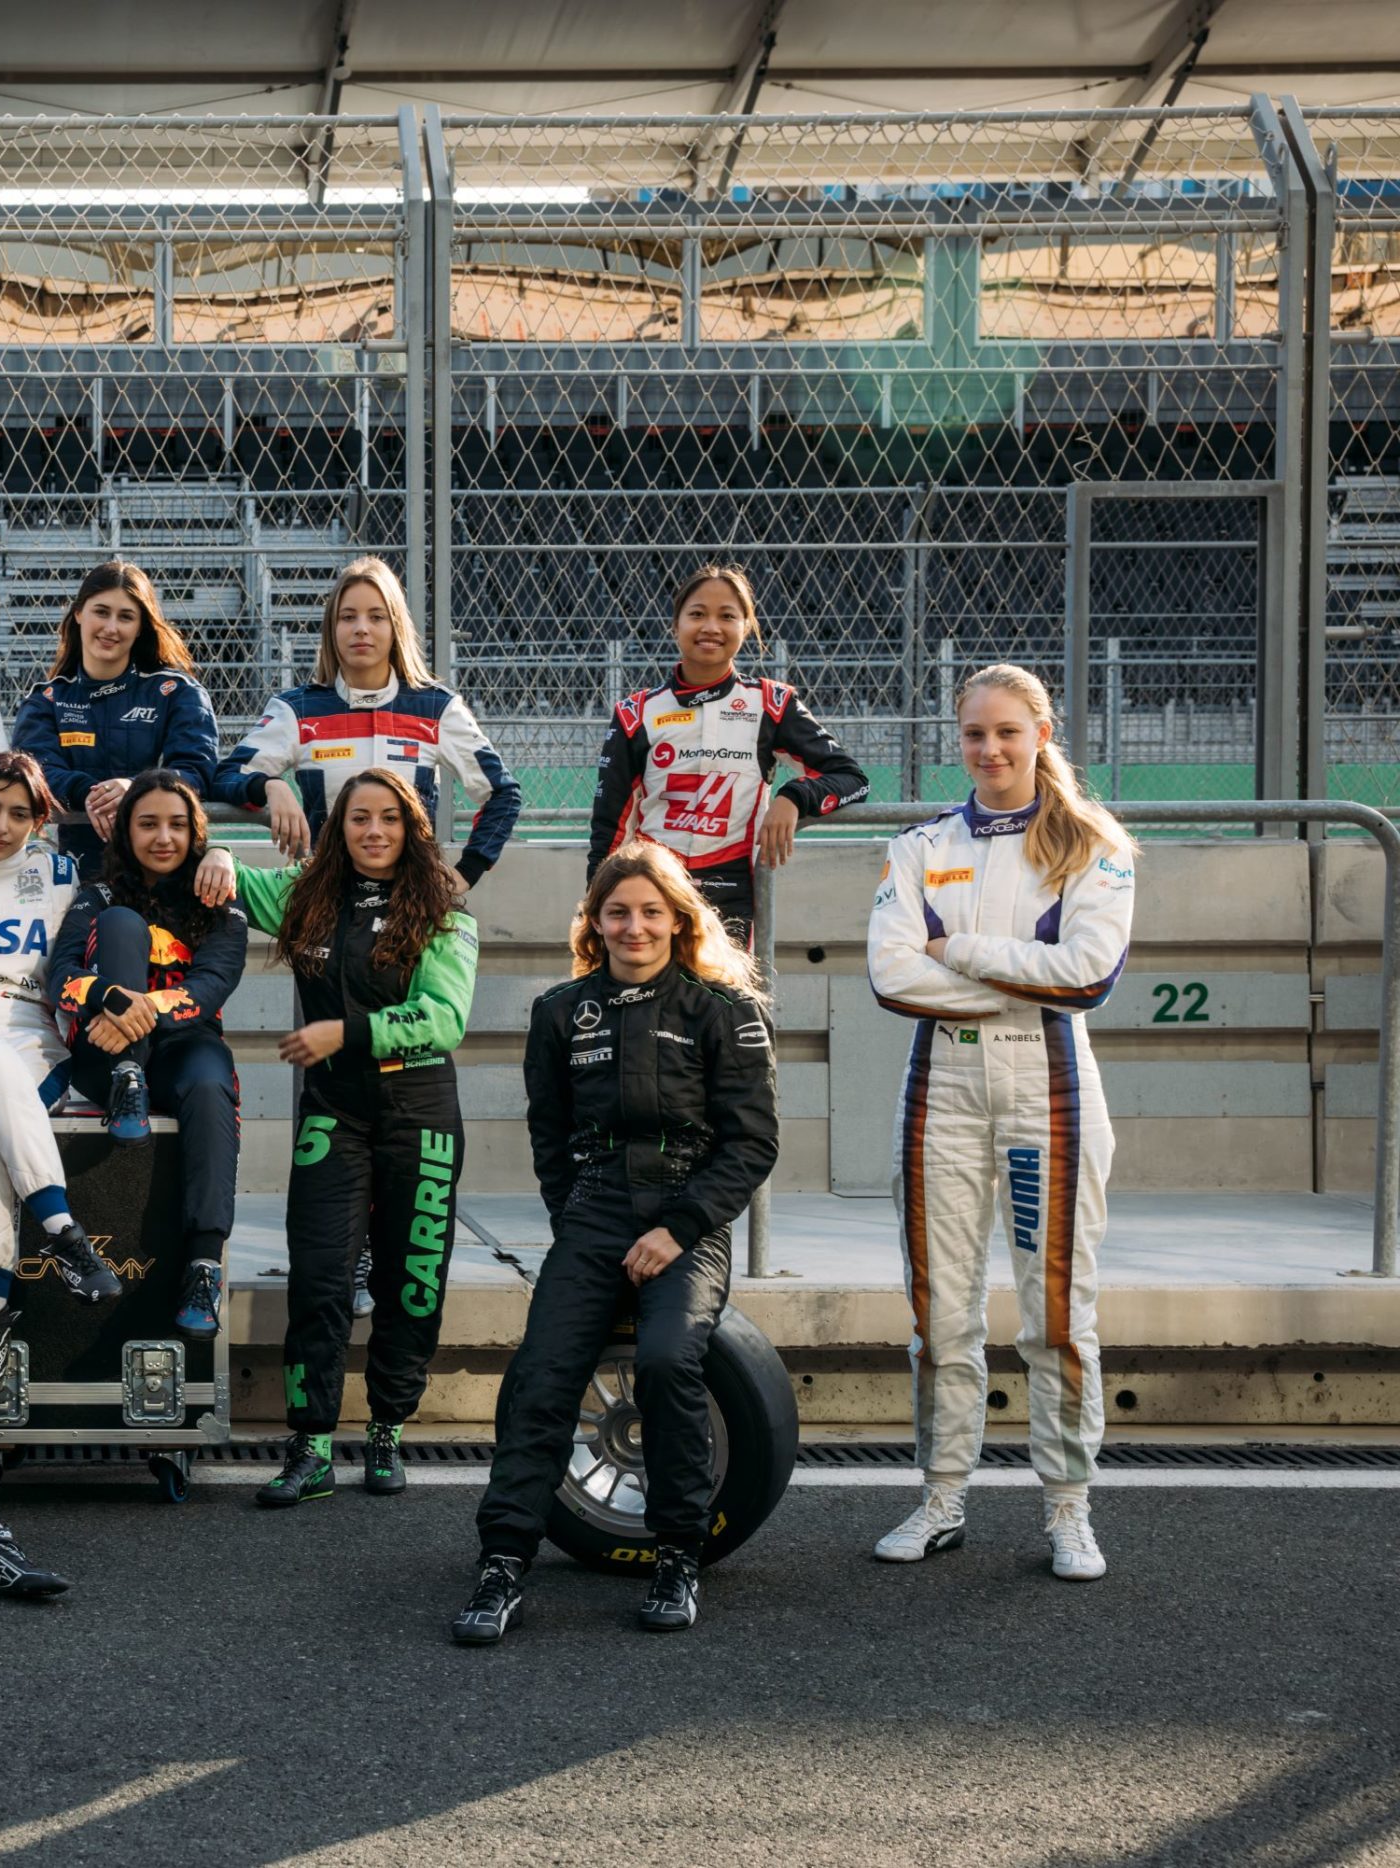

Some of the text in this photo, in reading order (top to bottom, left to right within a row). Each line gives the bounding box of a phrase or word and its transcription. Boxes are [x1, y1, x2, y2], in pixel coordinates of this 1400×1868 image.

[121, 707, 156, 720] ART
[315, 748, 352, 759] PIRELLI
[679, 748, 752, 760] MoneyGram
[671, 812, 723, 833] HAAS
[975, 820, 1028, 835] ACADEMY
[930, 871, 970, 885] PIRELLI
[608, 989, 655, 1006] ACADEMY
[1152, 982, 1209, 1023] 22
[993, 1034, 1041, 1042] A. NOBELS
[294, 1115, 337, 1166] 5
[1007, 1148, 1040, 1253] PUMA
[401, 1128, 454, 1317] CARRIE
